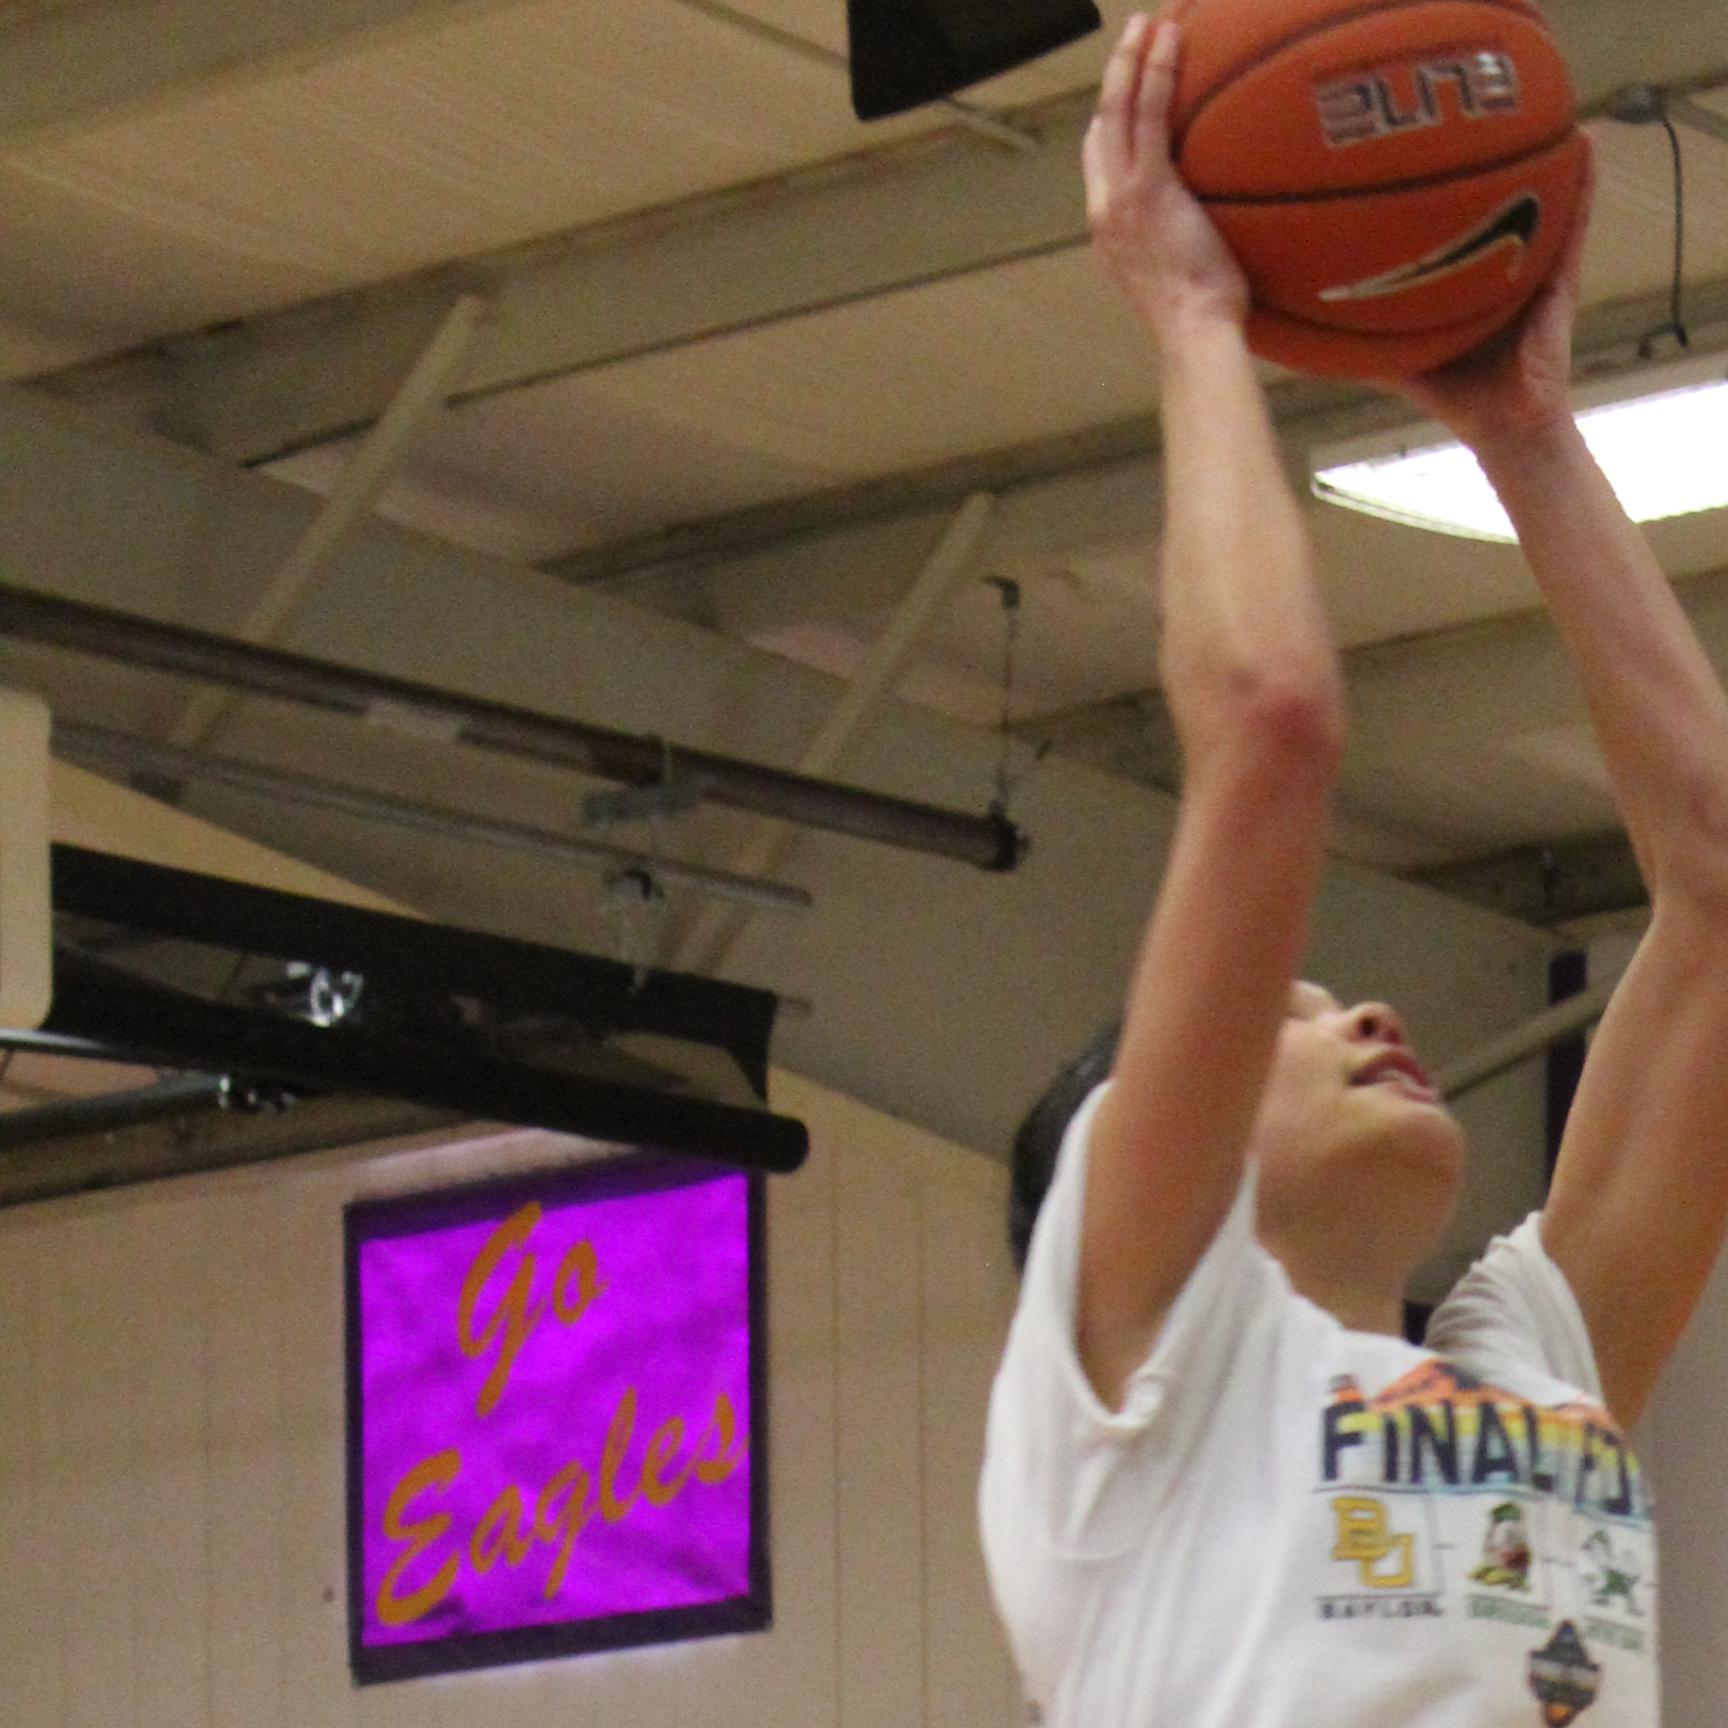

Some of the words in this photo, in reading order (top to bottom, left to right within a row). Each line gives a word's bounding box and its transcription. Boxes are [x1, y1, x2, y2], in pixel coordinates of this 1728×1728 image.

[456, 1202, 610, 1418] Go
[376, 1385, 751, 1626] Eagles
[1322, 1398, 1555, 1494] FINAL
